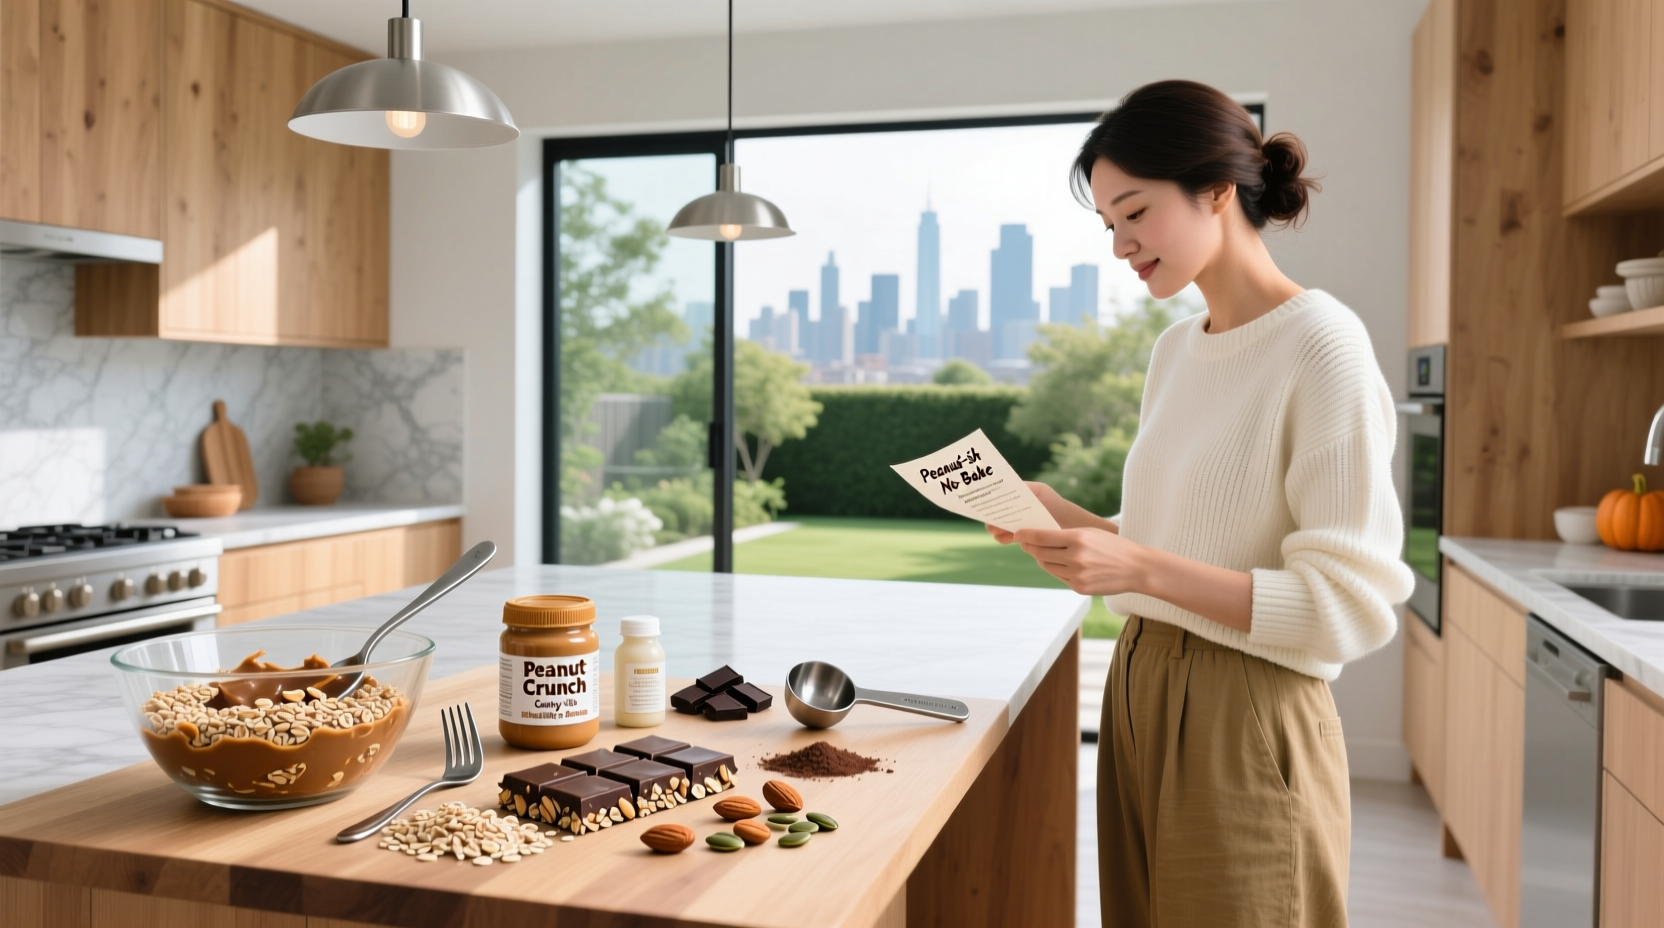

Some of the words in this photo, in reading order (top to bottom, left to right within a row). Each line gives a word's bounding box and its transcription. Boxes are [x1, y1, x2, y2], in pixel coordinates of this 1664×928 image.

[940, 478, 960, 495] No
[960, 465, 993, 485] Bake
[523, 659, 587, 677] Peanut
[523, 677, 587, 696] Crunch
